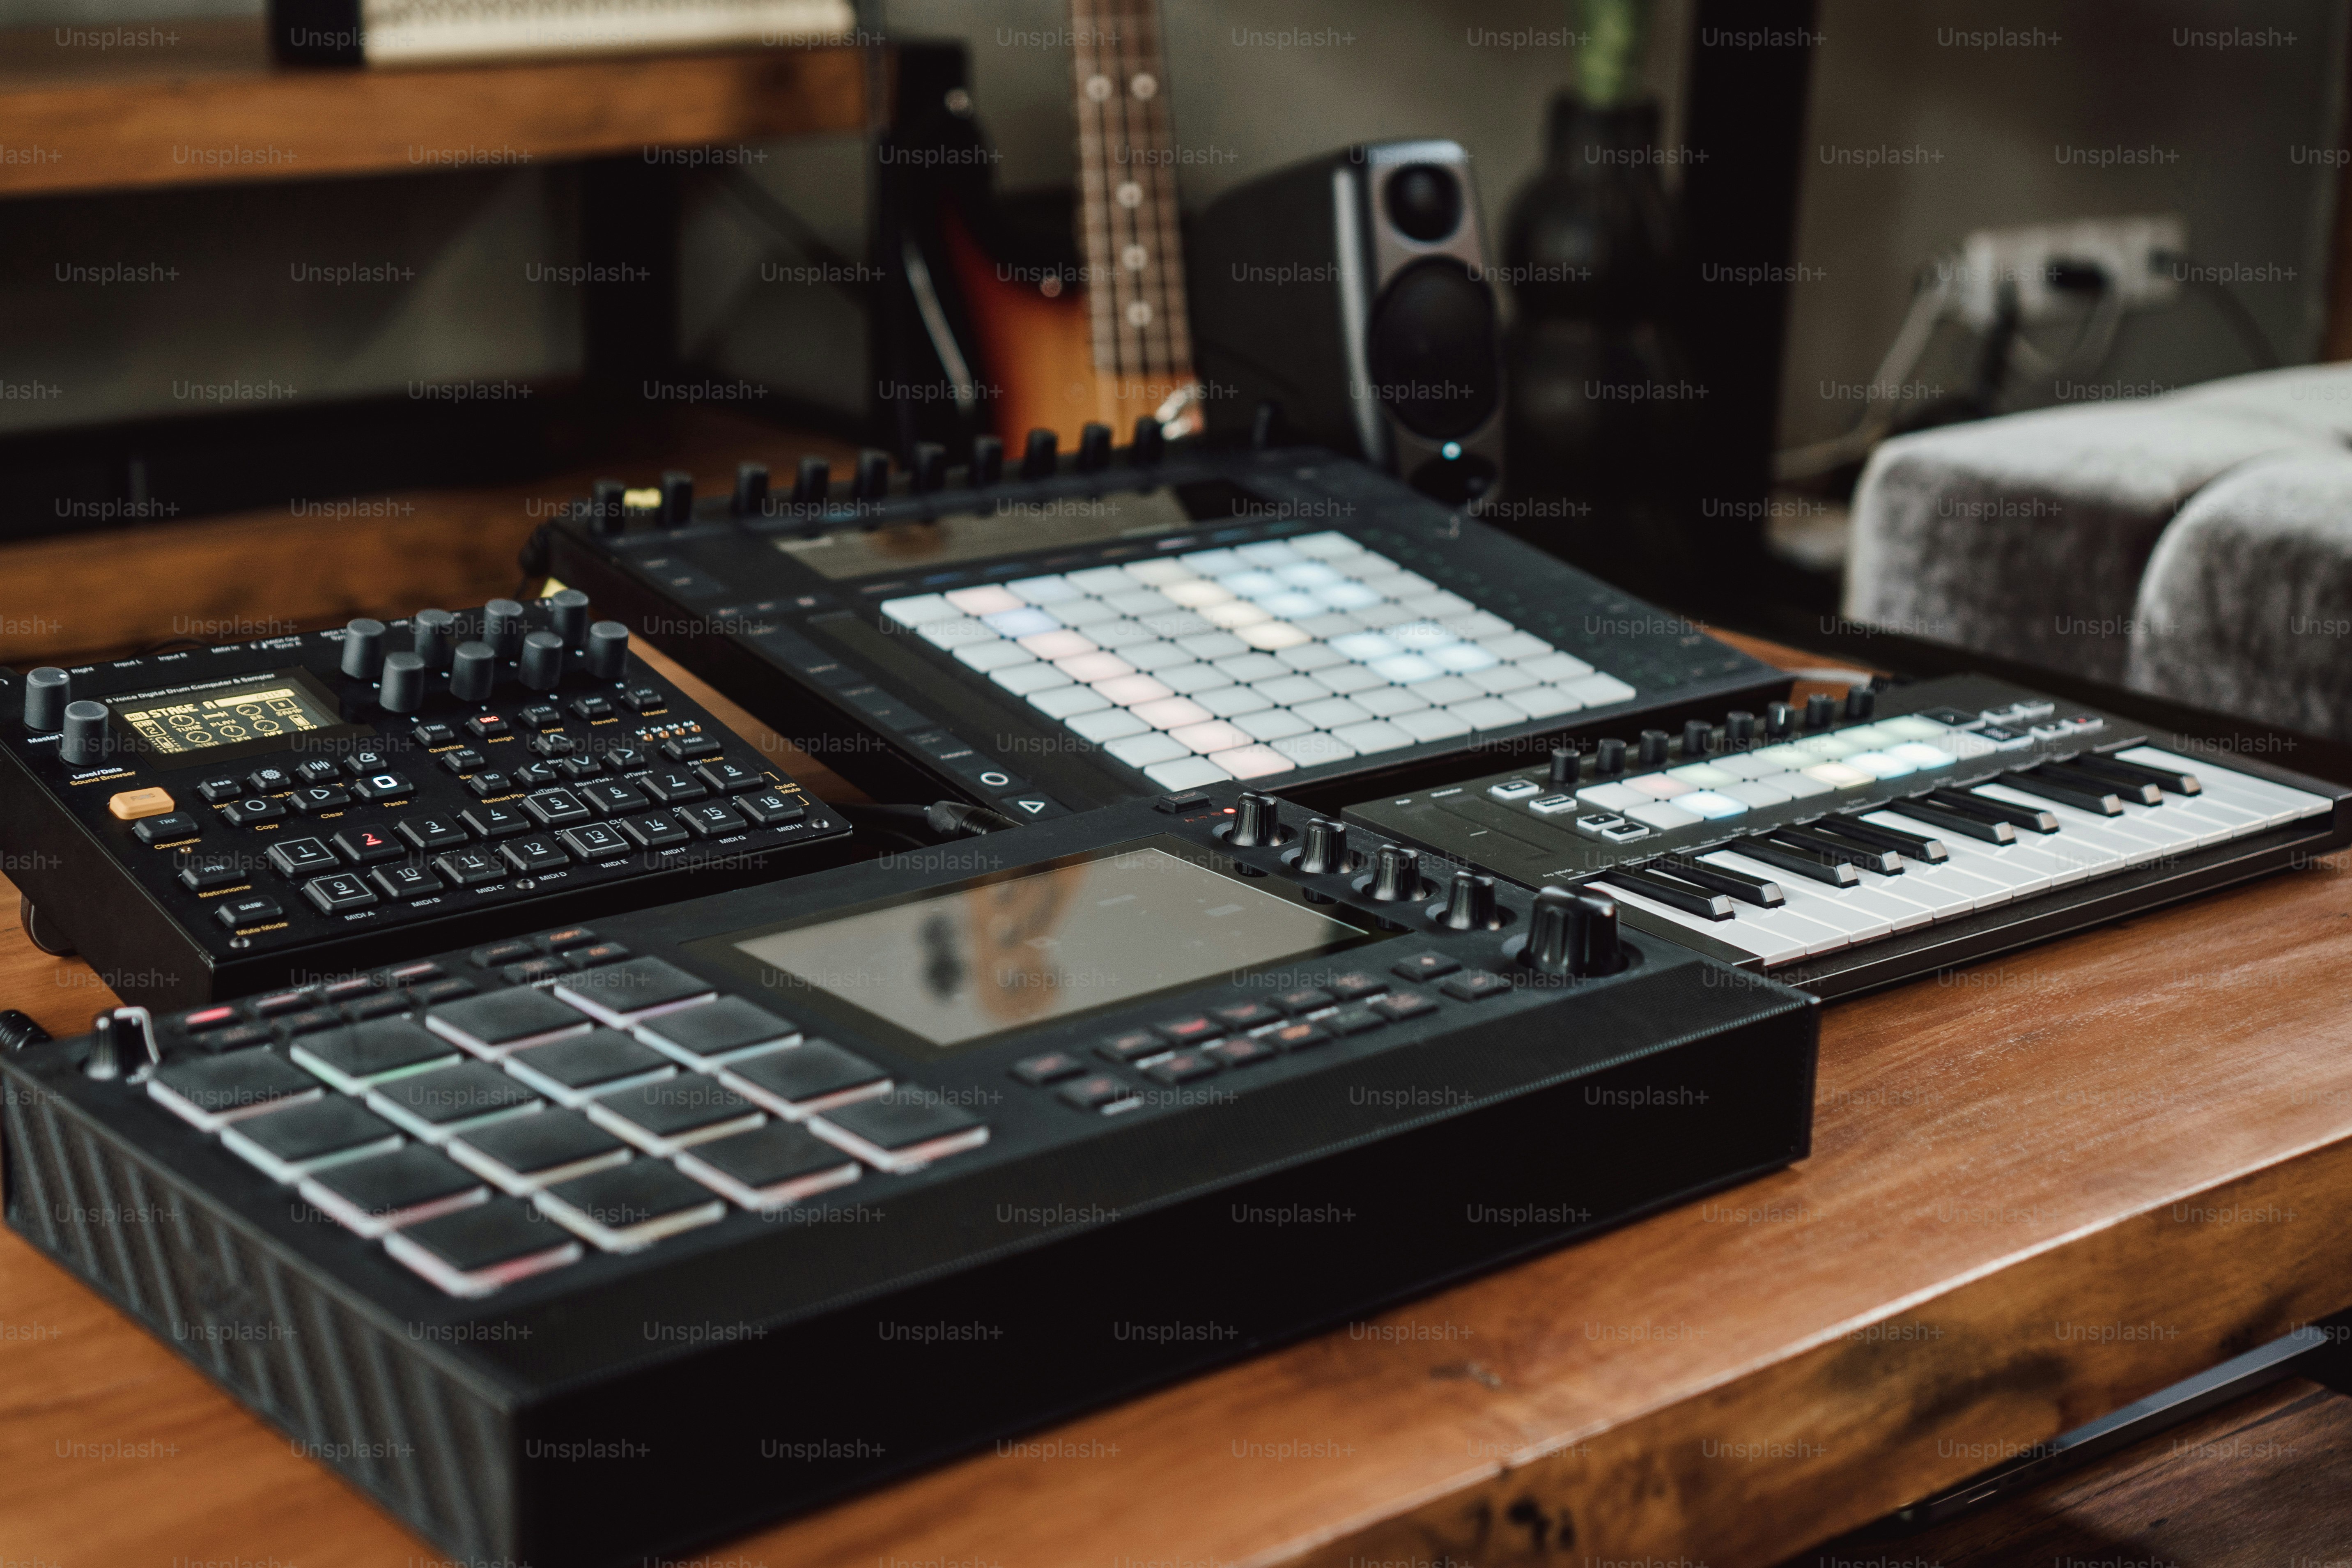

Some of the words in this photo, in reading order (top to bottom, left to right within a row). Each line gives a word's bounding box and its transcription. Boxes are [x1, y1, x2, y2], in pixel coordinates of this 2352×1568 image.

[113, 694, 138, 703] Voice
[138, 689, 166, 700] Digital
[166, 685, 190, 694] Drum
[191, 680, 232, 692] Computer
[240, 673, 275, 684] Sampler
[148, 703, 200, 719] STAGE
[202, 701, 217, 710] A
[641, 708, 668, 716] Master
[591, 718, 618, 726] Reverb
[176, 724, 204, 732] TUNE
[28, 734, 59, 744] Master
[488, 735, 515, 744] Assign
[429, 744, 464, 753] Quantize
[72, 766, 123, 779] Level/Data
[70, 777, 100, 786] Sound
[100, 770, 136, 781] Browser
[774, 782, 797, 791] Quick
[781, 787, 802, 795] Mute
[482, 795, 511, 804] Reload
[760, 796, 780, 806] 16
[321, 811, 344, 820] Clear
[703, 807, 722, 817] 15
[645, 819, 664, 829] 14
[586, 830, 605, 840] 13
[154, 838, 201, 850] Chromatic
[524, 843, 545, 852] 12
[462, 856, 480, 865] 11
[396, 868, 418, 879] 10
[539, 873, 559, 882] MIDI
[199, 885, 251, 898] Metronome
[475, 886, 497, 894] MIDI
[238, 902, 264, 911] BANK
[411, 899, 433, 907] MIDI
[344, 912, 367, 921] MIDI
[236, 927, 260, 936] Mute
[260, 922, 288, 932] Mode
